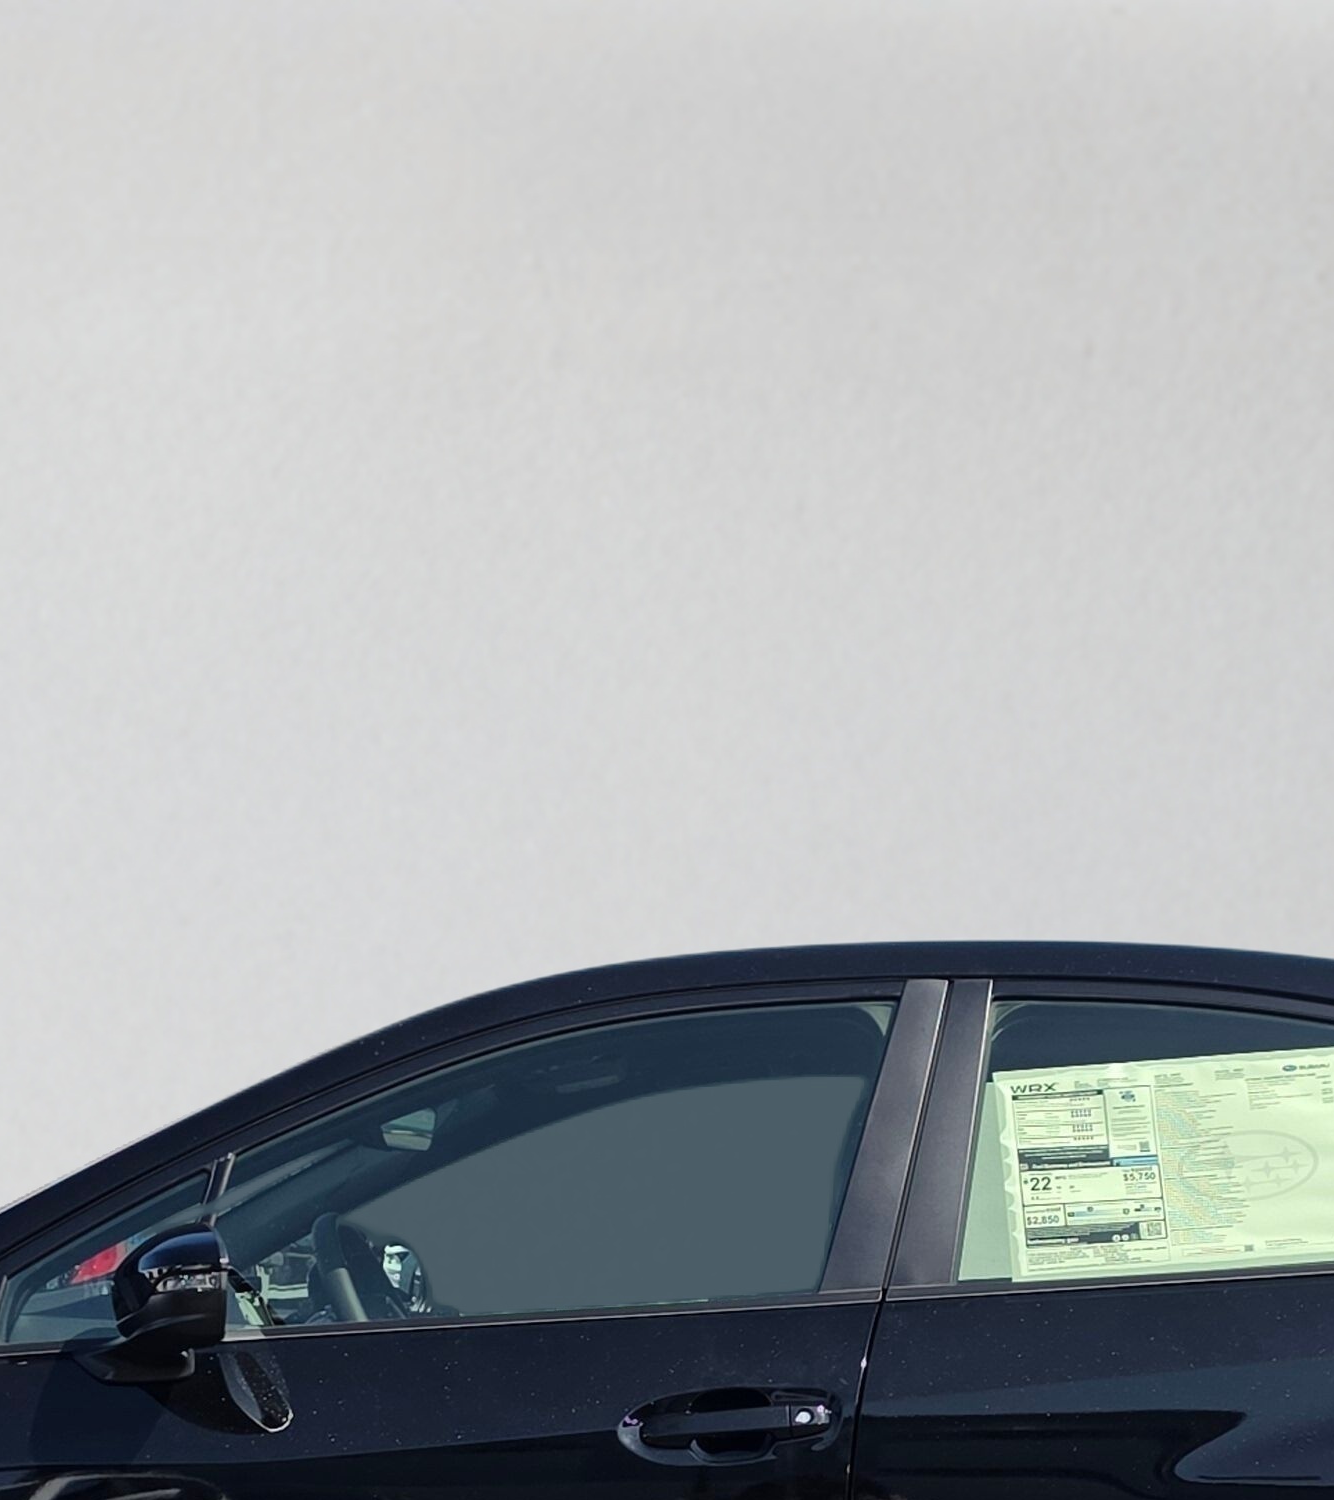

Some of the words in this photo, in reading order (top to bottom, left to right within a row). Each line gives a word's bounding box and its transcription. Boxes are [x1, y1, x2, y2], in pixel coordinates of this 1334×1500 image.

[1010, 1082, 1059, 1094] WRX
[1123, 1172, 1156, 1181] $5,750
[1030, 1176, 1052, 1191] 22
